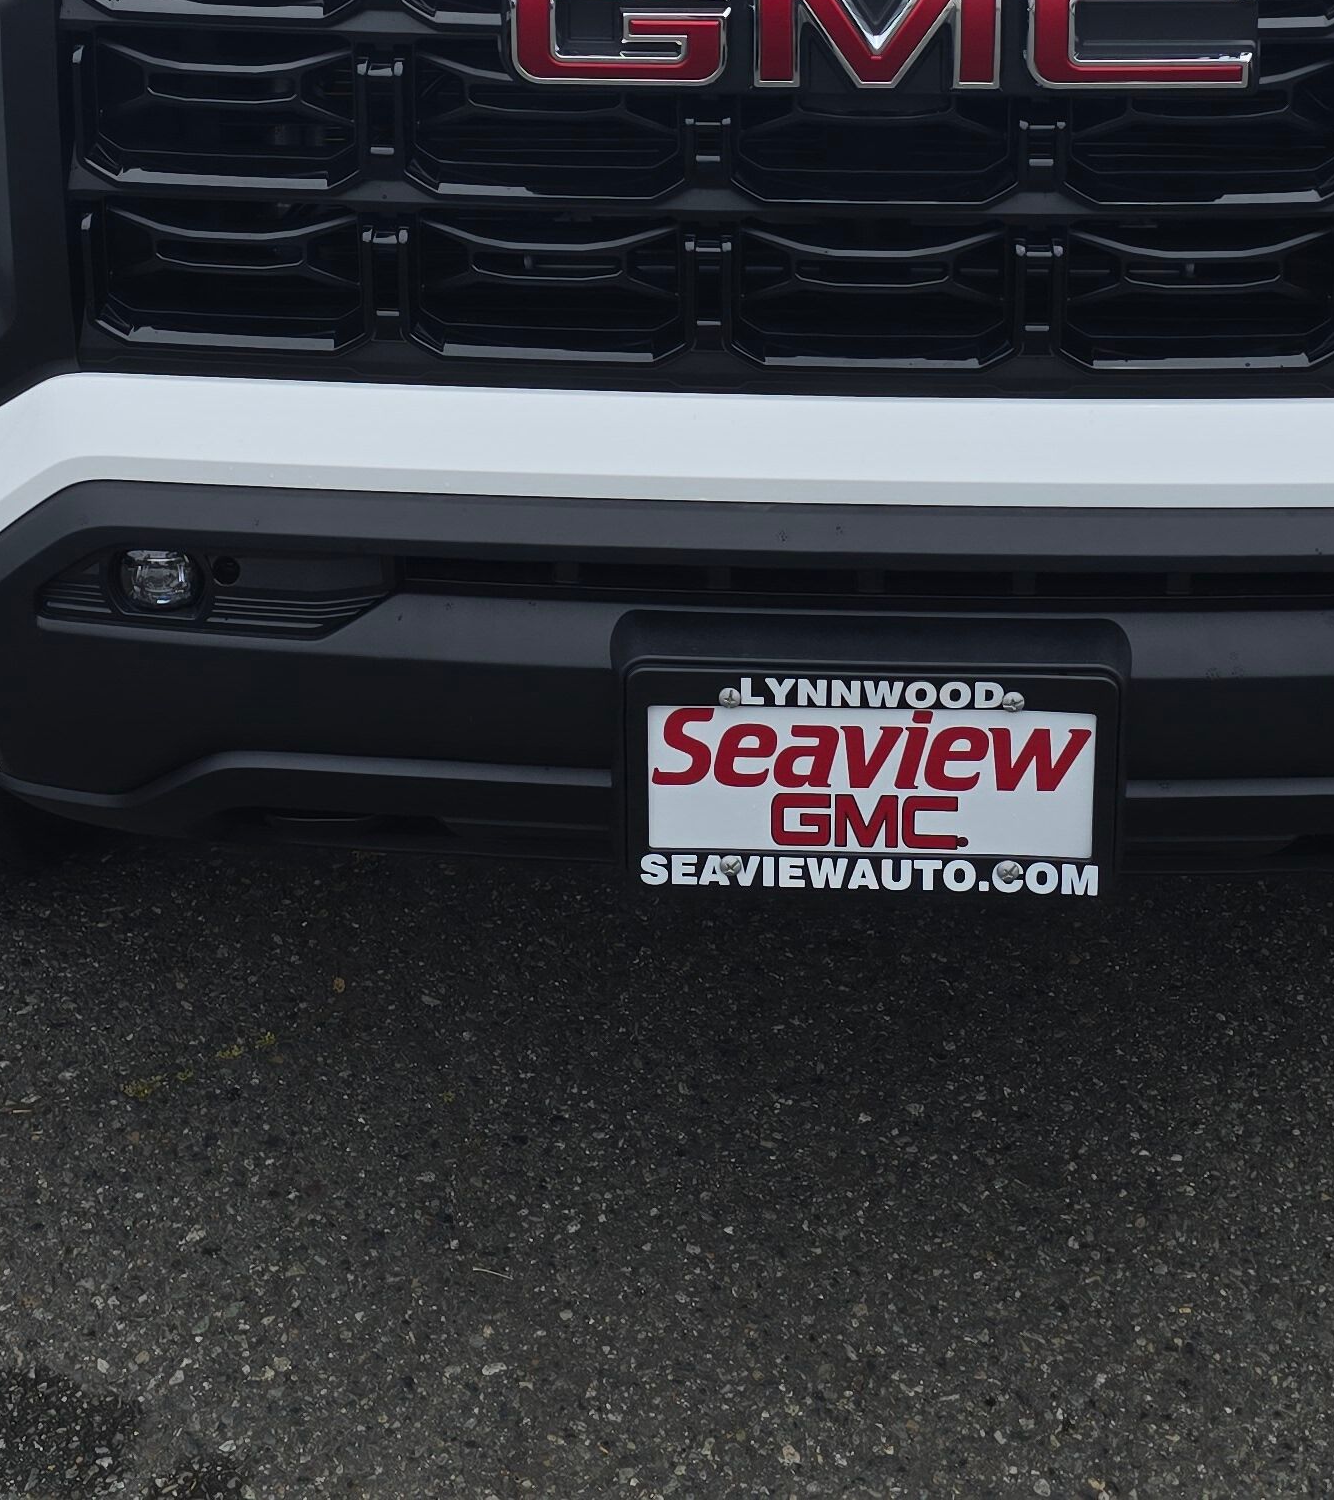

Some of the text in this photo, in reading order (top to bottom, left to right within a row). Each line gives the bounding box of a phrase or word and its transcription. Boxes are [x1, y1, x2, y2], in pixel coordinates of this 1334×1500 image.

[741, 678, 1005, 709] LYNNWOOD
[651, 708, 1092, 791] Seaview
[771, 793, 961, 850] GMC
[640, 854, 1099, 896] SEAVIEWAUTO.COM
